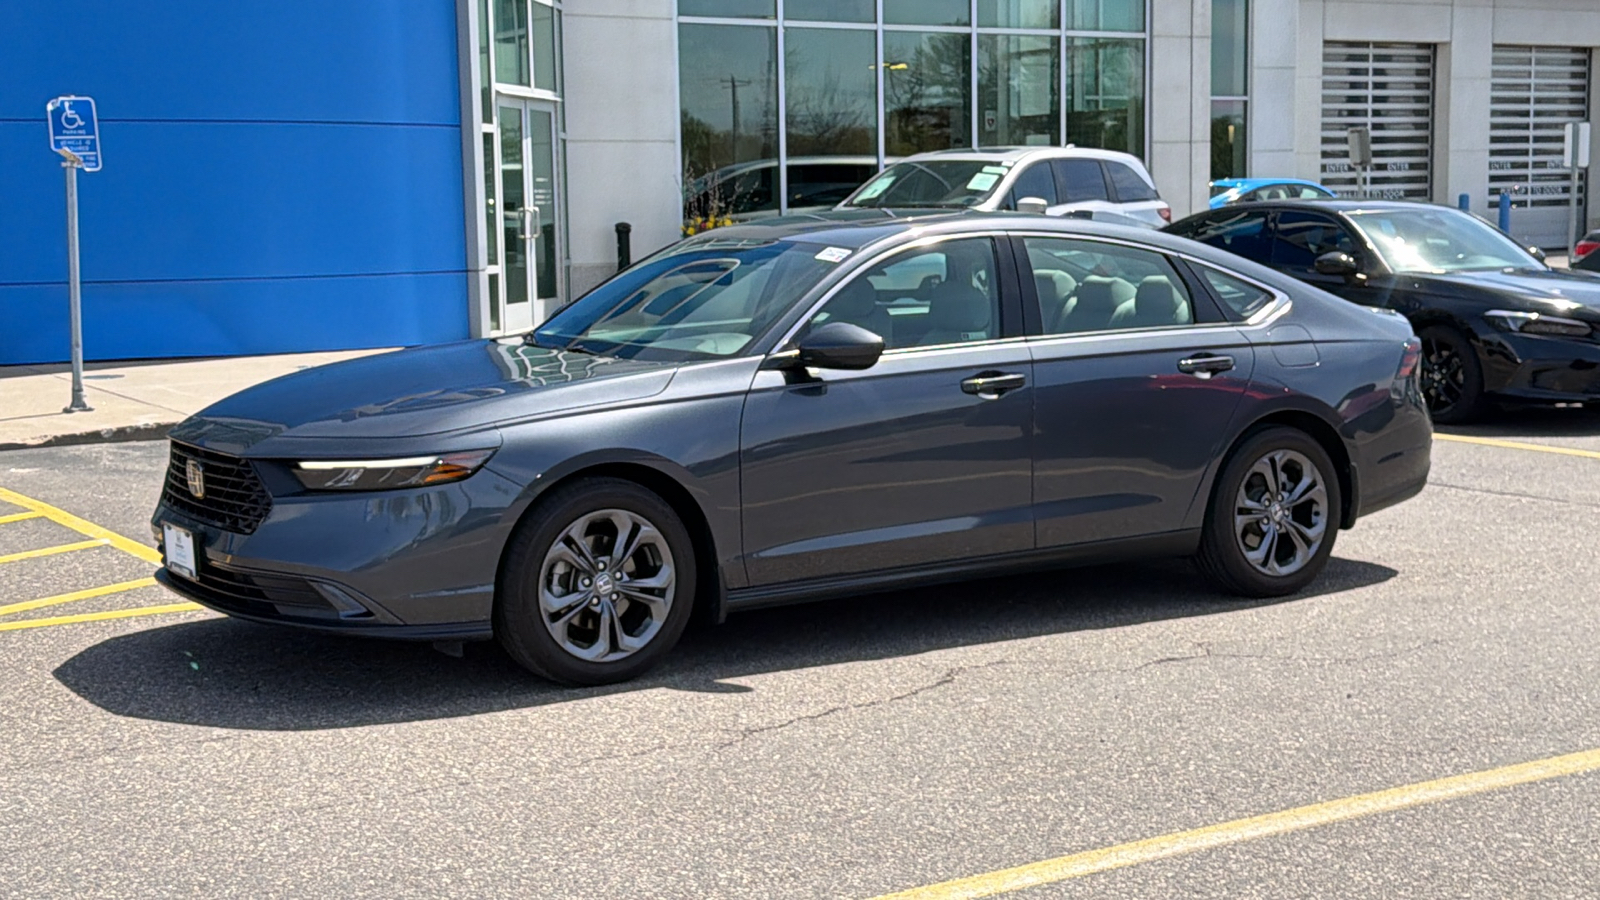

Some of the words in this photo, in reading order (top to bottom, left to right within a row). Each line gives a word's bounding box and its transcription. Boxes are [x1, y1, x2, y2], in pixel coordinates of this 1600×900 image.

[1326, 163, 1348, 173] ENTER
[1387, 162, 1409, 172] ENTER
[1491, 161, 1511, 170] ENTER
[1547, 160, 1564, 170] ENTE
